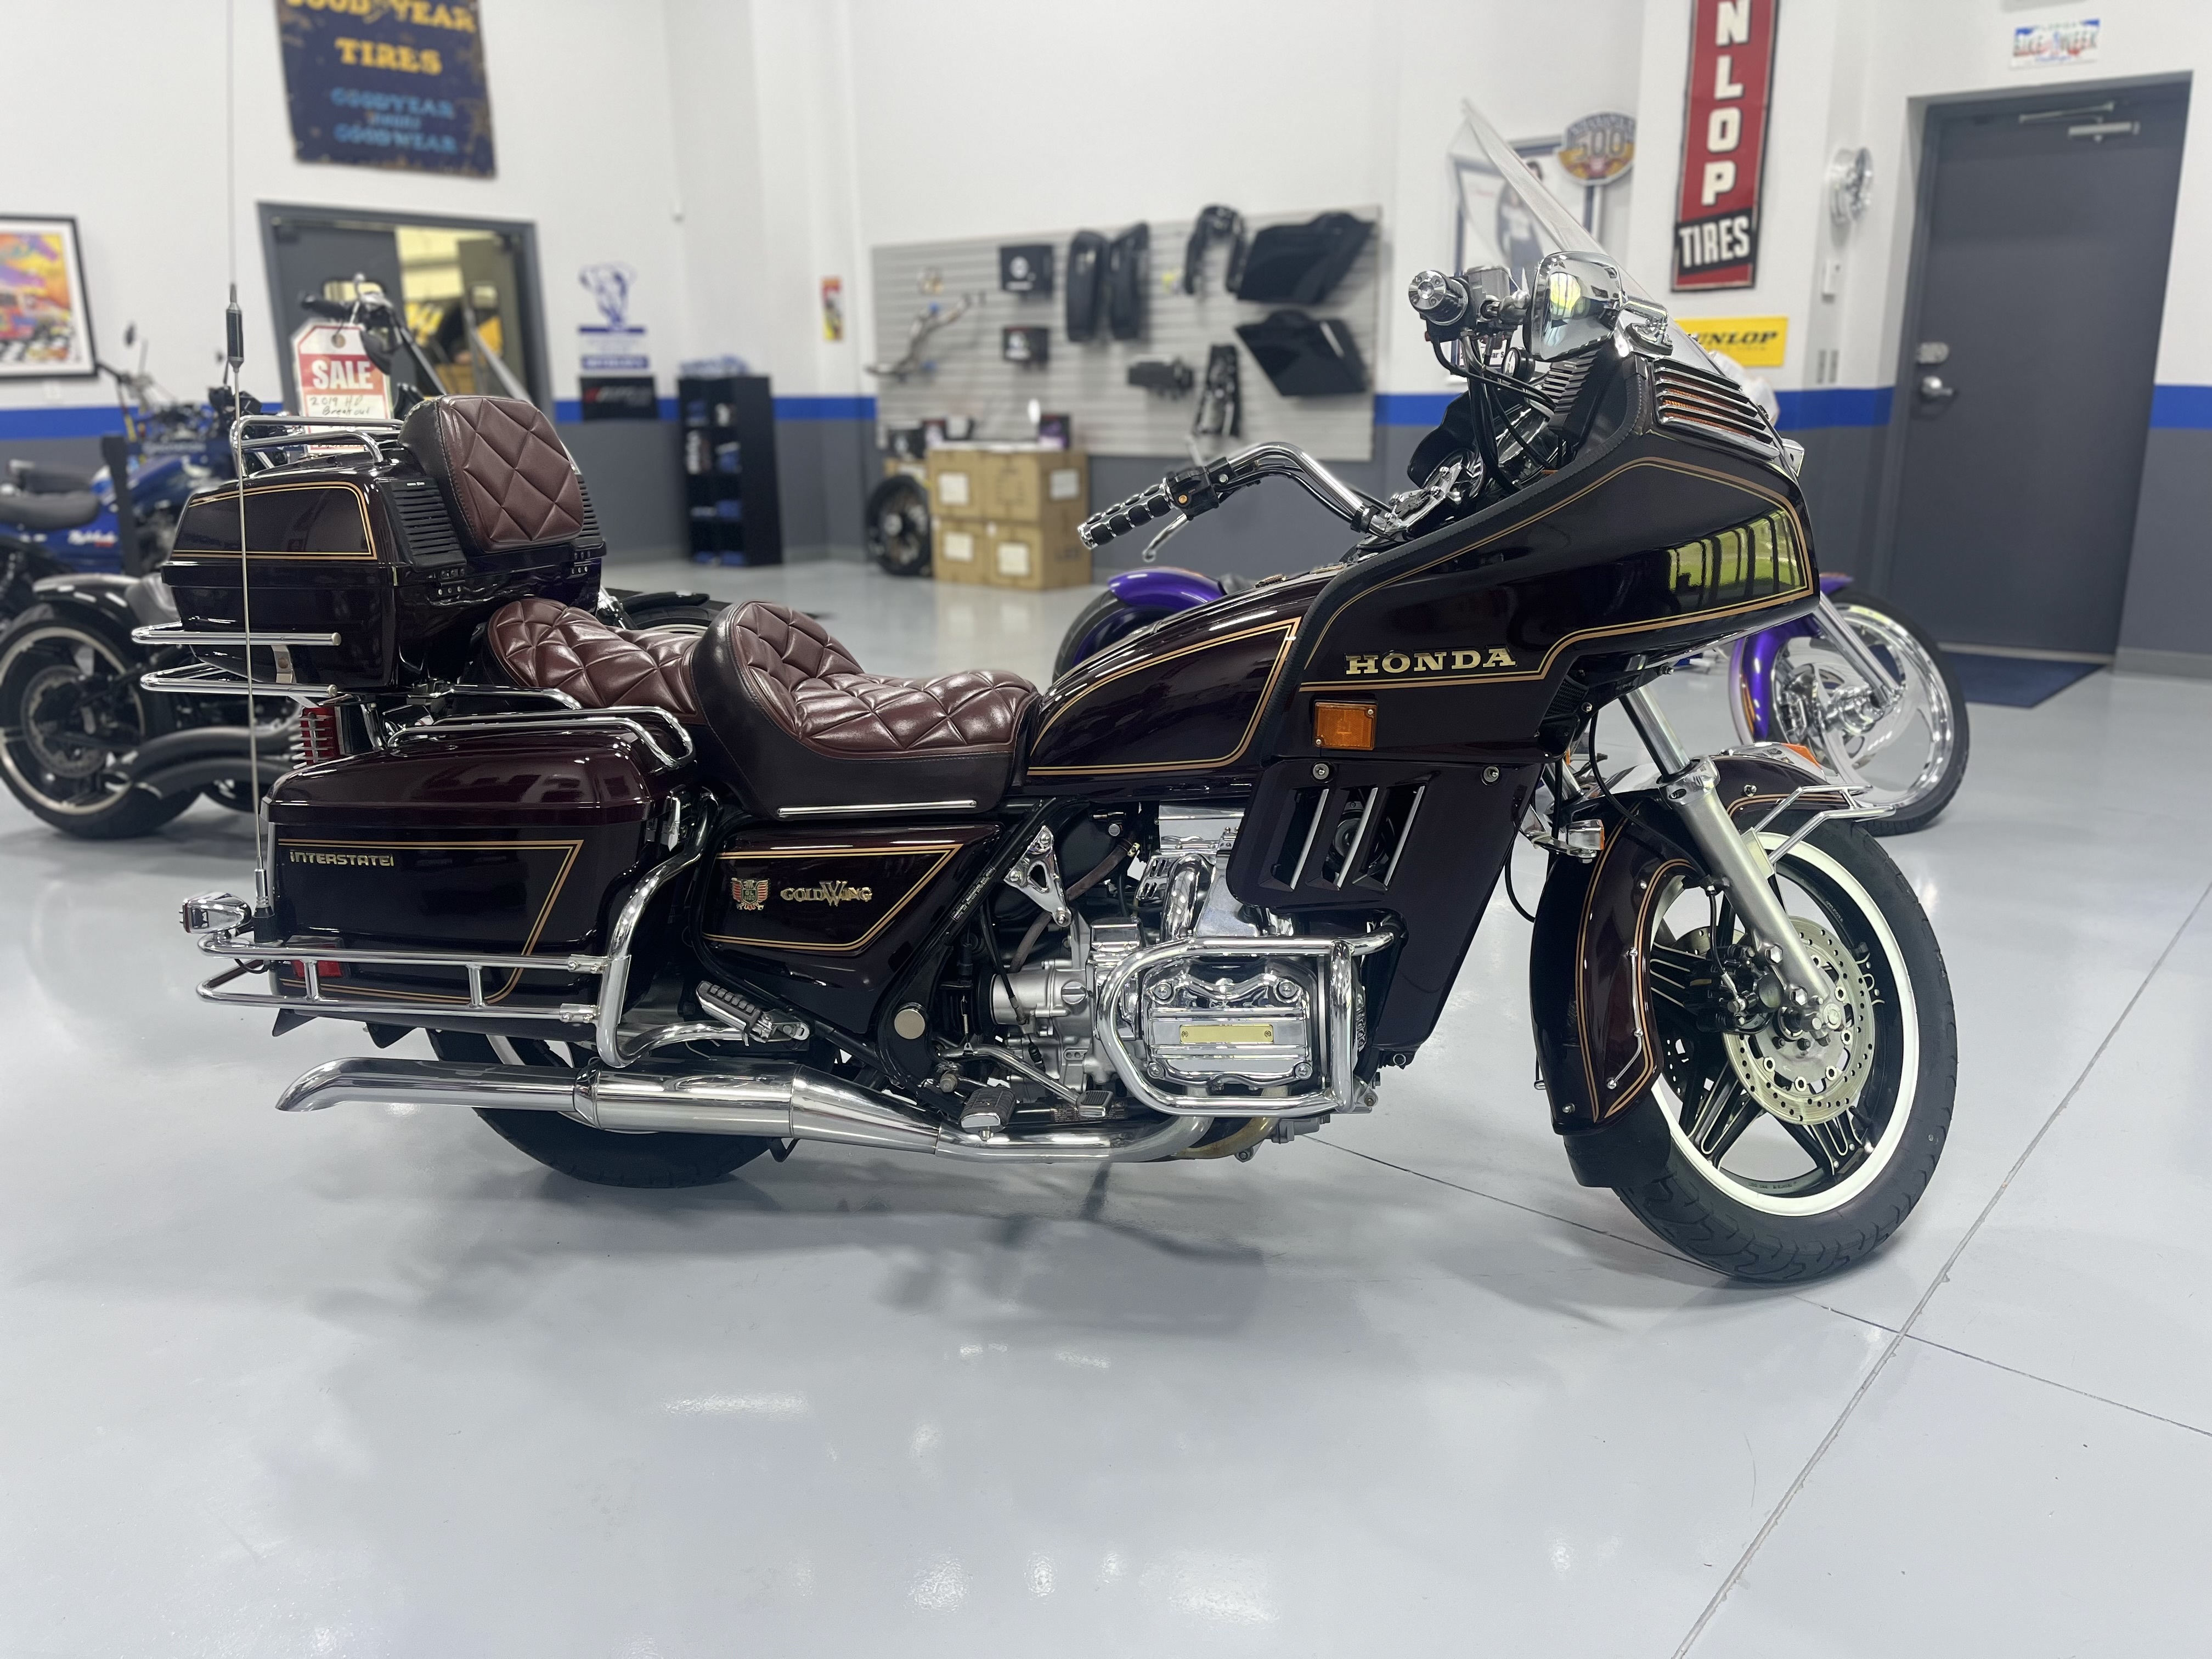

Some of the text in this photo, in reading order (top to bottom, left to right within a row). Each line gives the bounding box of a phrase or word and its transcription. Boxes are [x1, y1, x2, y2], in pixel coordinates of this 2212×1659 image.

[335, 37, 443, 75] TIRES
[1679, 216, 1750, 268] TIRES
[311, 359, 374, 390] SALE
[309, 396, 338, 407] 2019
[1345, 648, 1517, 675] HONDA
